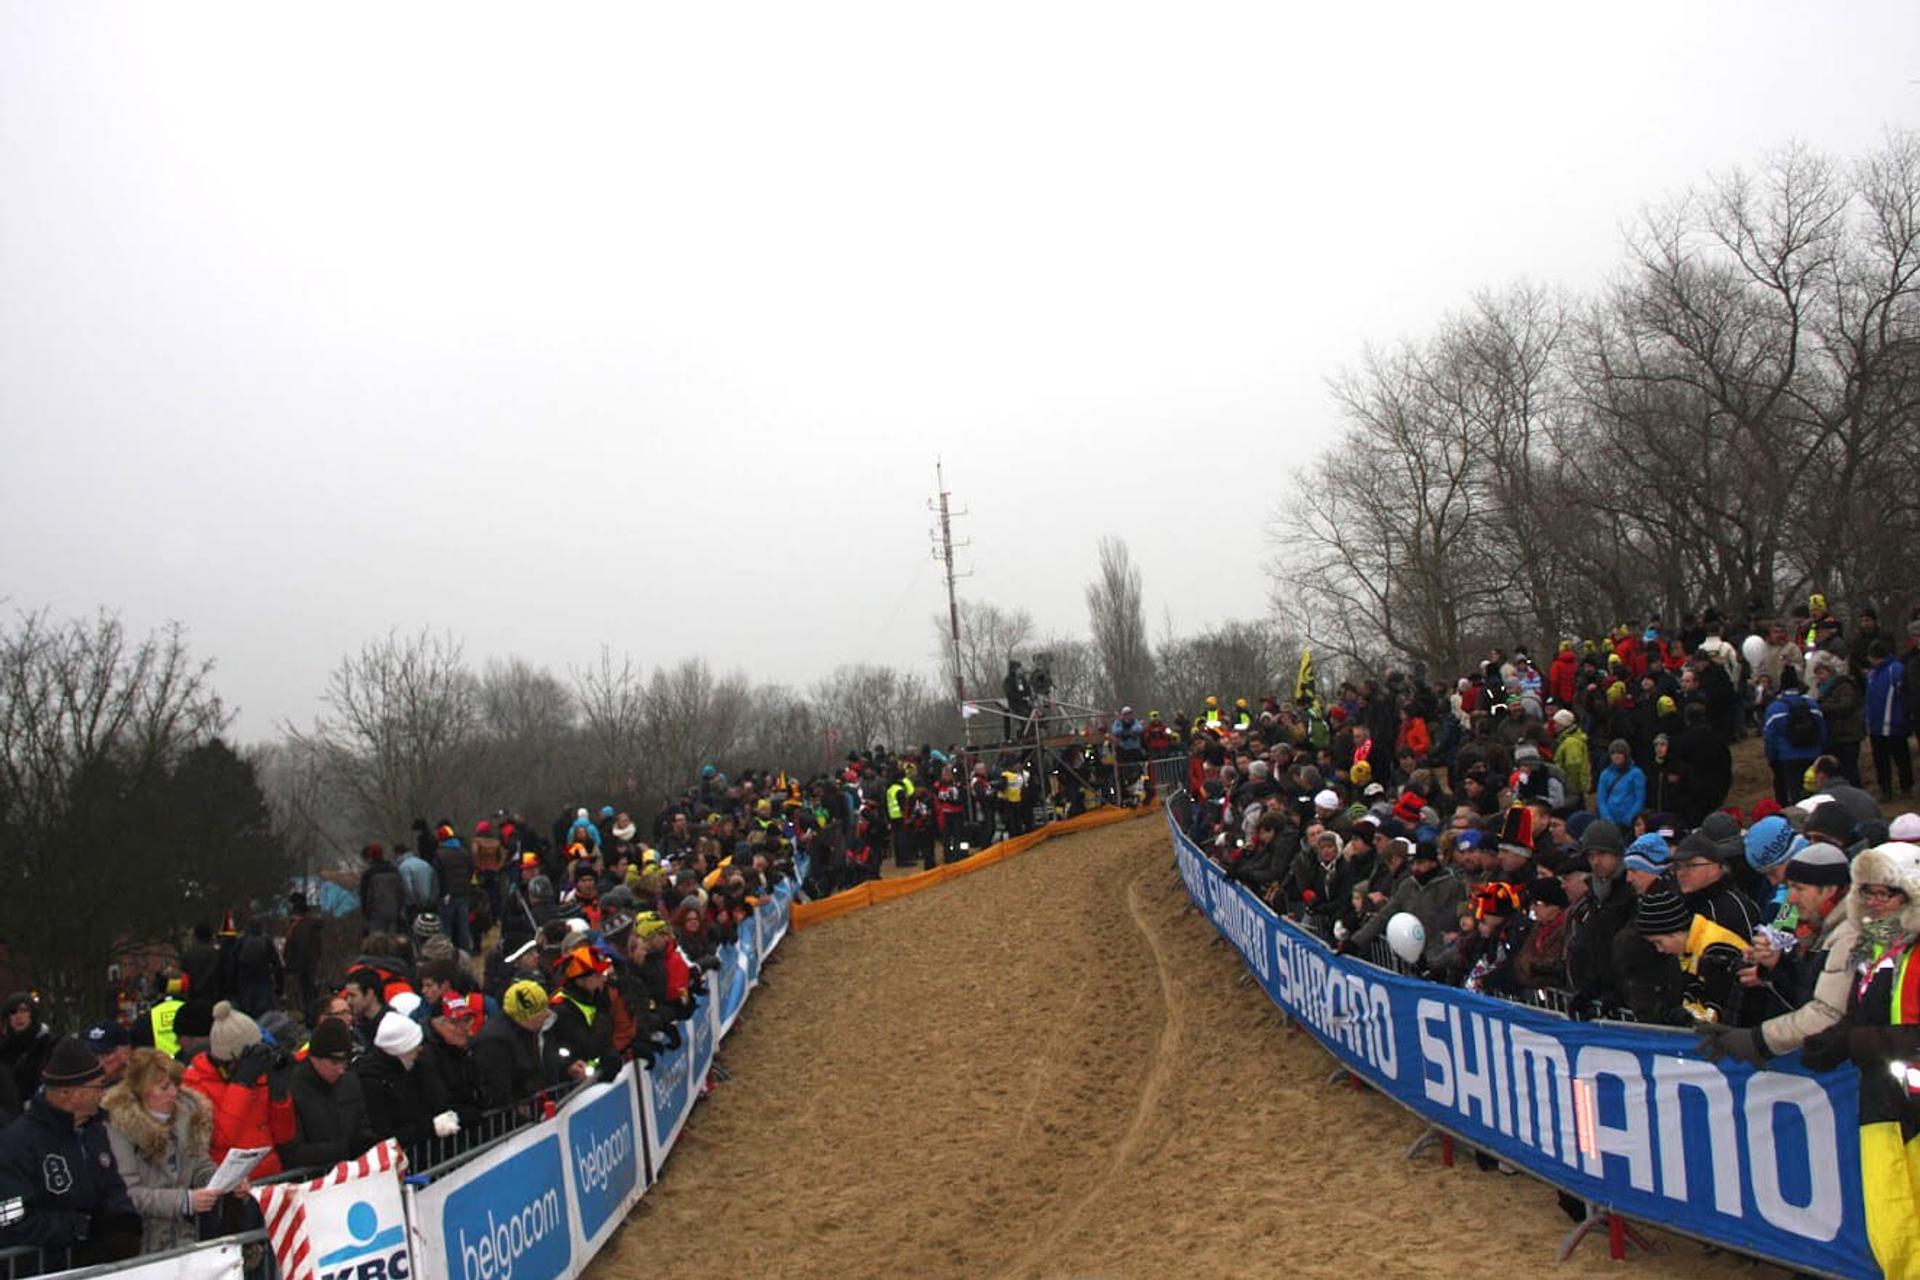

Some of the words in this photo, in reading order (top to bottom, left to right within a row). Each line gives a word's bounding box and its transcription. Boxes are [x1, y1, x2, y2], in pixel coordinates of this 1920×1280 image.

[1276, 930, 1397, 1080] SHIMANO
[575, 1123, 631, 1193] belgacom
[1417, 998, 1843, 1242] SHIMANO
[461, 1187, 560, 1280] belgacom
